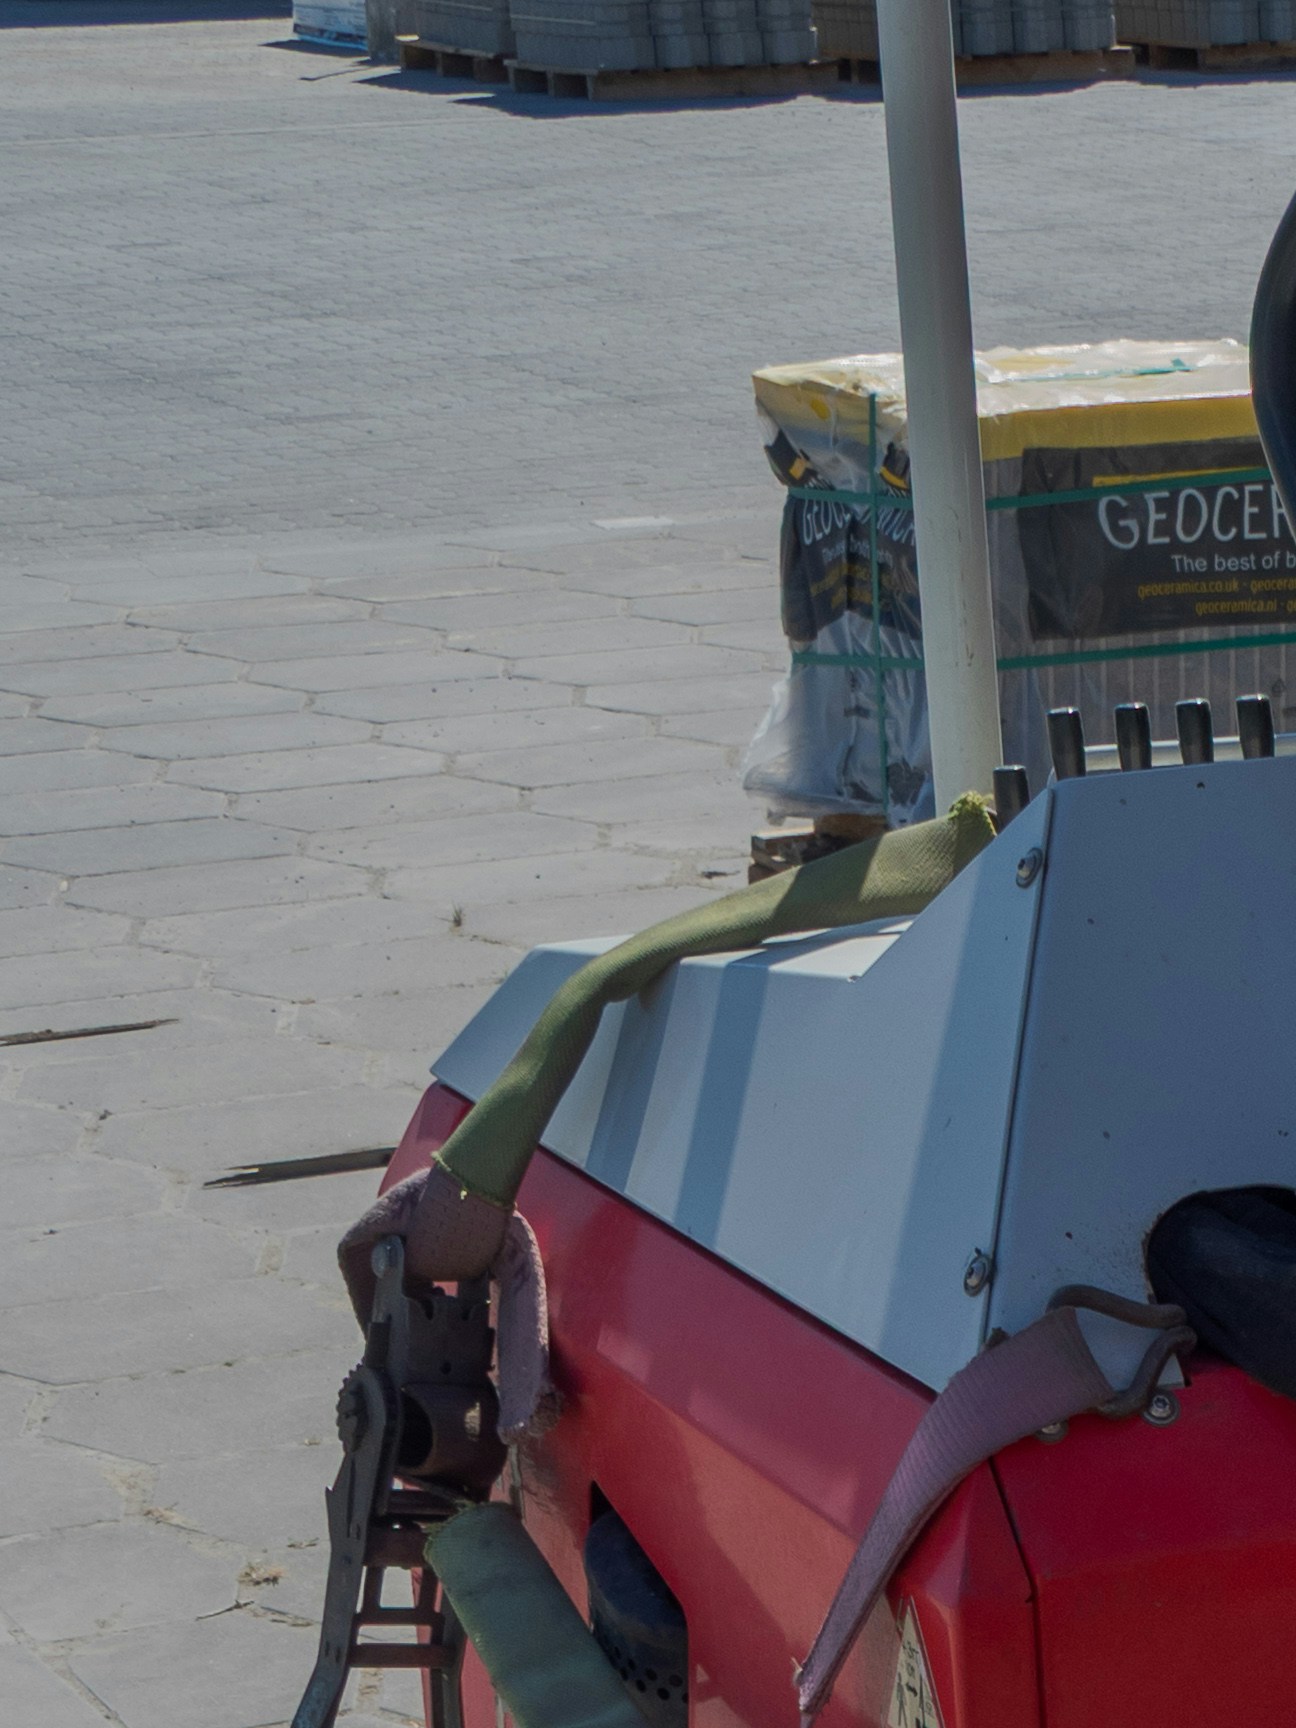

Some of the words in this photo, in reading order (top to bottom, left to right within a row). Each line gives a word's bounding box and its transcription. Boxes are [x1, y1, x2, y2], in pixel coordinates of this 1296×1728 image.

[1171, 553, 1207, 573] The
[1214, 552, 1256, 572] best
[1262, 550, 1280, 568] of
